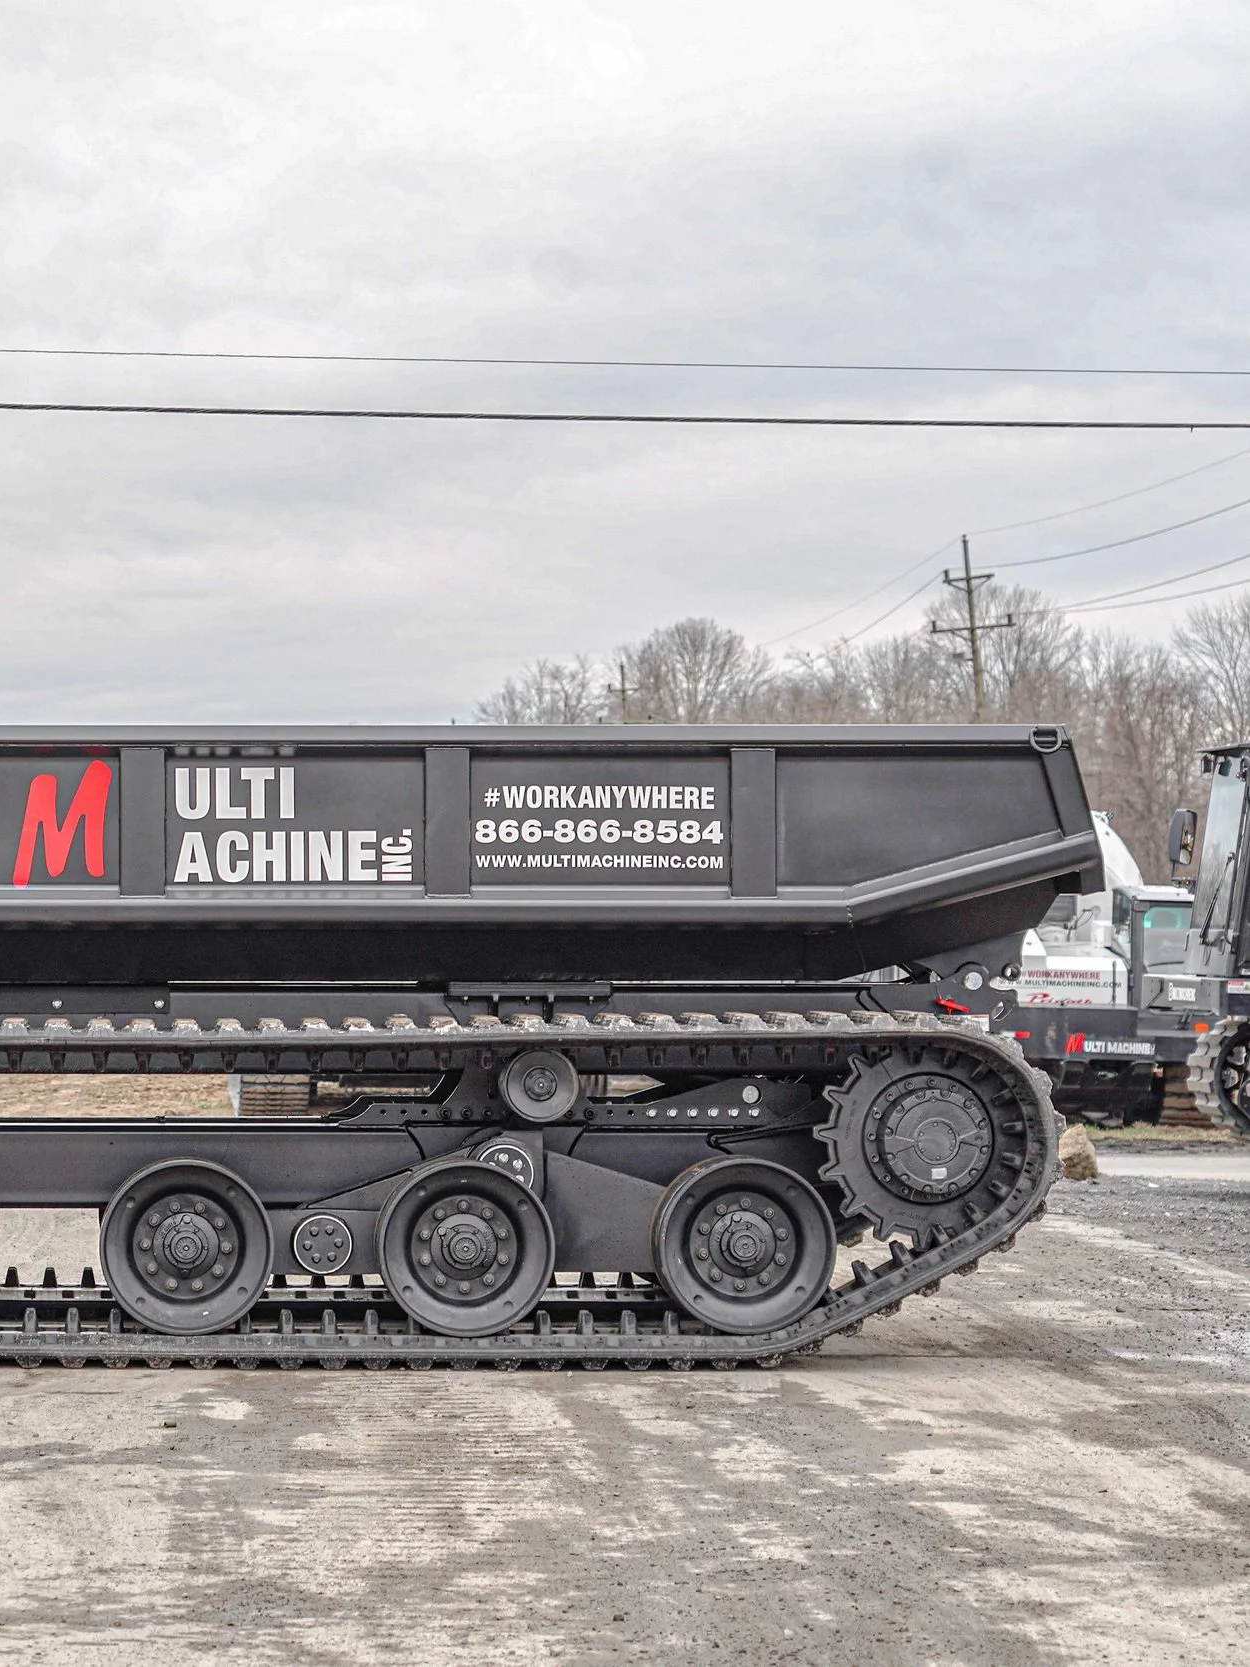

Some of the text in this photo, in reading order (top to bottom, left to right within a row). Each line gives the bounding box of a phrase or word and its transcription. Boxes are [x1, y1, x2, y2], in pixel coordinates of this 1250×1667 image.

[174, 766, 295, 820] ULTI
[484, 785, 715, 810] #WORKANYWHERE
[475, 819, 724, 844] 866-866-8584
[173, 829, 413, 883] ACHINE INC.
[475, 854, 724, 869] WWW.MULTIMACHINEINC.COM
[1107, 1041, 1151, 1055] MACHINE
